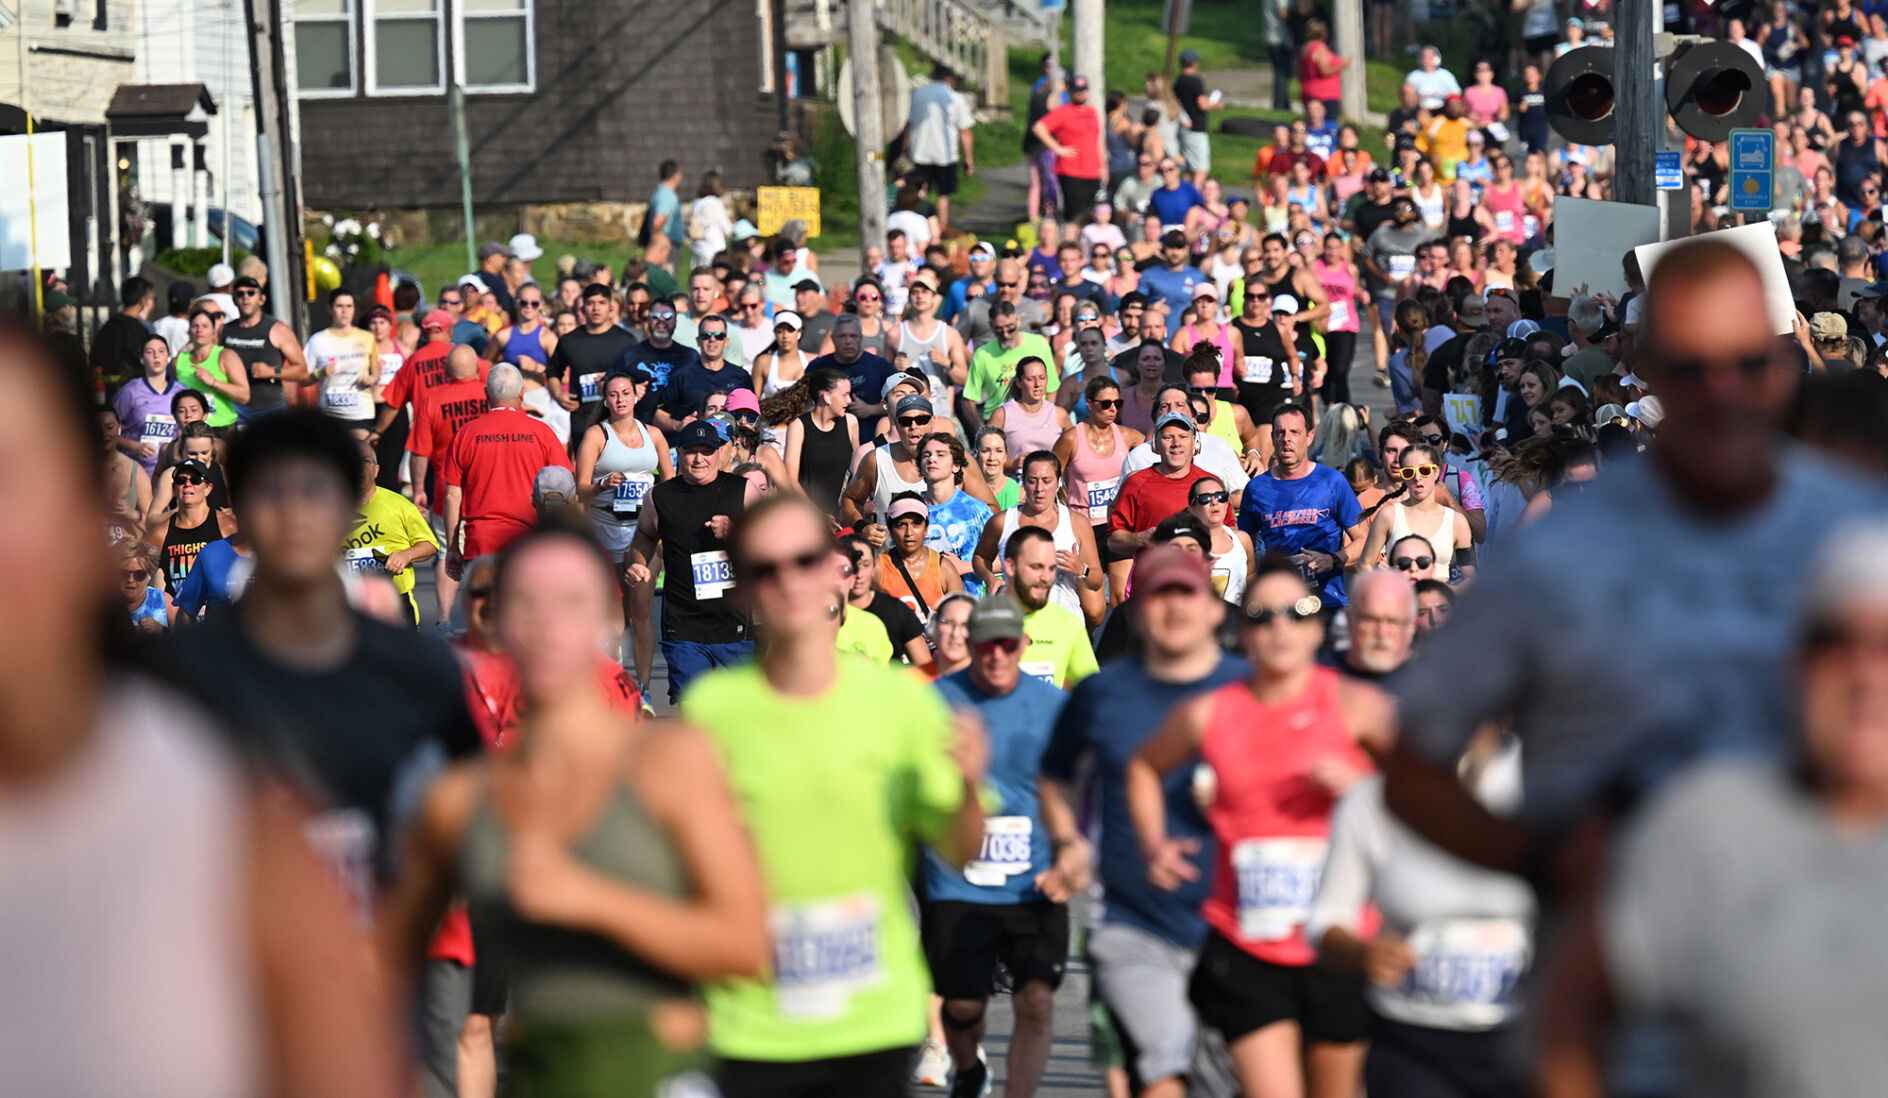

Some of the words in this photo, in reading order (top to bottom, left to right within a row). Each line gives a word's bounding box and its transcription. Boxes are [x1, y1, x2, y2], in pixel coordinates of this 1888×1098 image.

[415, 357, 447, 375] FINIS
[441, 399, 490, 420] FINISH
[145, 422, 175, 436] 16124
[452, 416, 481, 434] LI
[475, 434, 509, 444] FINISH
[512, 433, 534, 443] LINE
[1271, 515, 1319, 528] LACROSSE
[169, 554, 197, 579] LI
